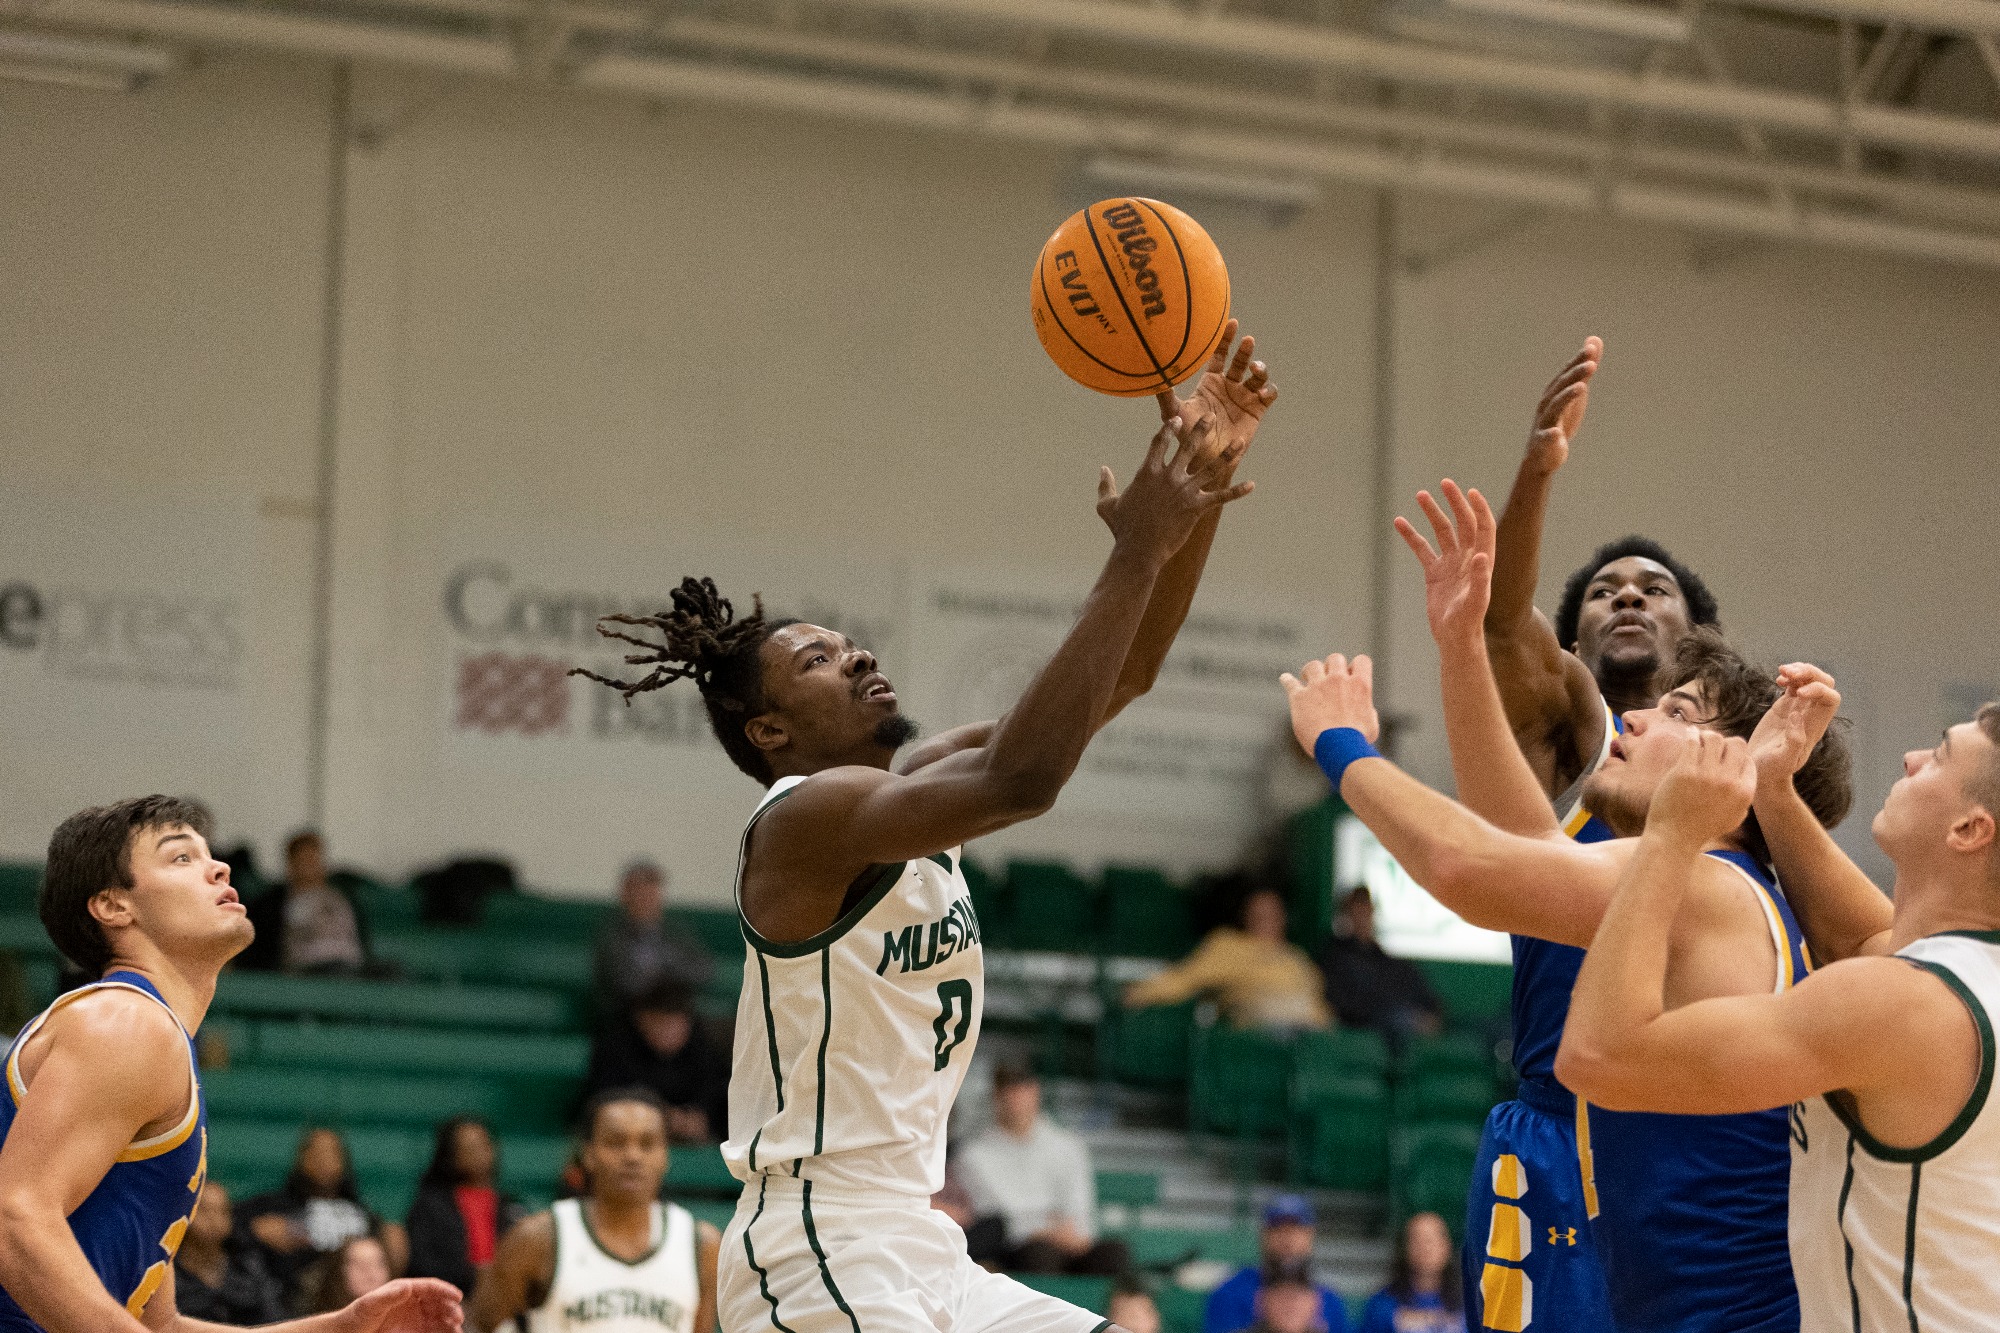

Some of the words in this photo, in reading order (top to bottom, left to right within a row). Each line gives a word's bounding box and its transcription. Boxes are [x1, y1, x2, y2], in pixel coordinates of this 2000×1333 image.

[1055, 250, 1100, 317] EVO
[1096, 313, 1119, 335] NXT
[1102, 203, 1167, 320] Wilson
